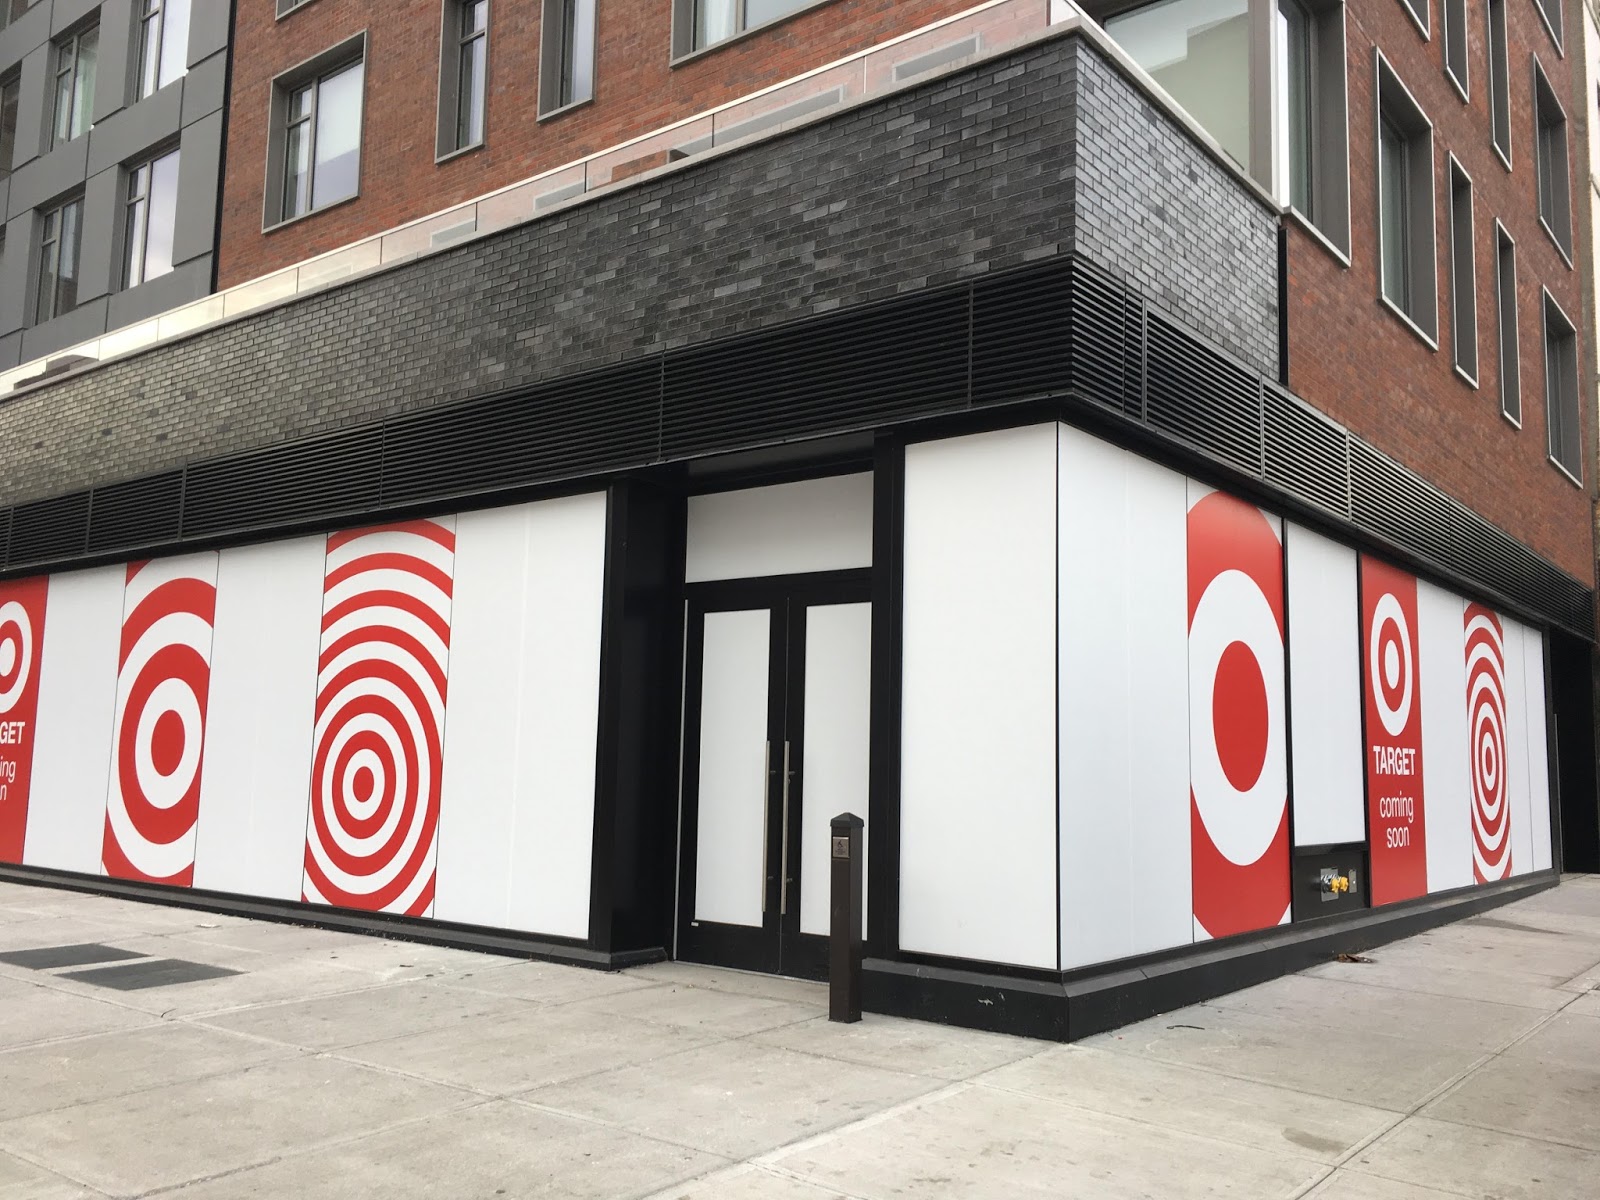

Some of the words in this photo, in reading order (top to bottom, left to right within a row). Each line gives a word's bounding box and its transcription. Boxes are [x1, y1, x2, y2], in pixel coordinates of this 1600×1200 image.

[1373, 745, 1416, 775] TARGET
[1379, 790, 1414, 823] coming
[1386, 826, 1410, 848] soon
